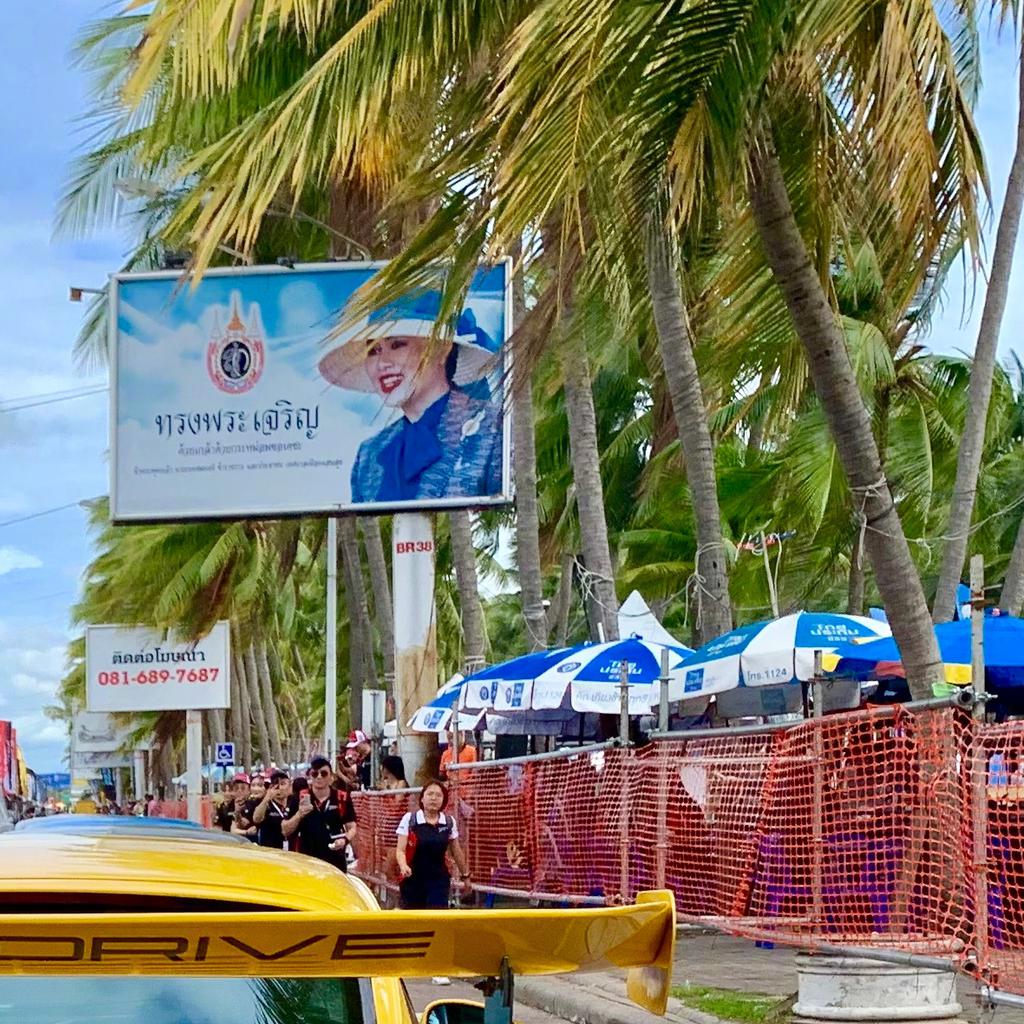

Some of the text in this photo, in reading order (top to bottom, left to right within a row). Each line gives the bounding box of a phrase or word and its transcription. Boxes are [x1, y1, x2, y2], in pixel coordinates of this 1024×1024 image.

[155, 399, 319, 439] ทรงพระเจริญ
[397, 541, 432, 554] BR38
[98, 667, 219, 685] 081-689-7687
